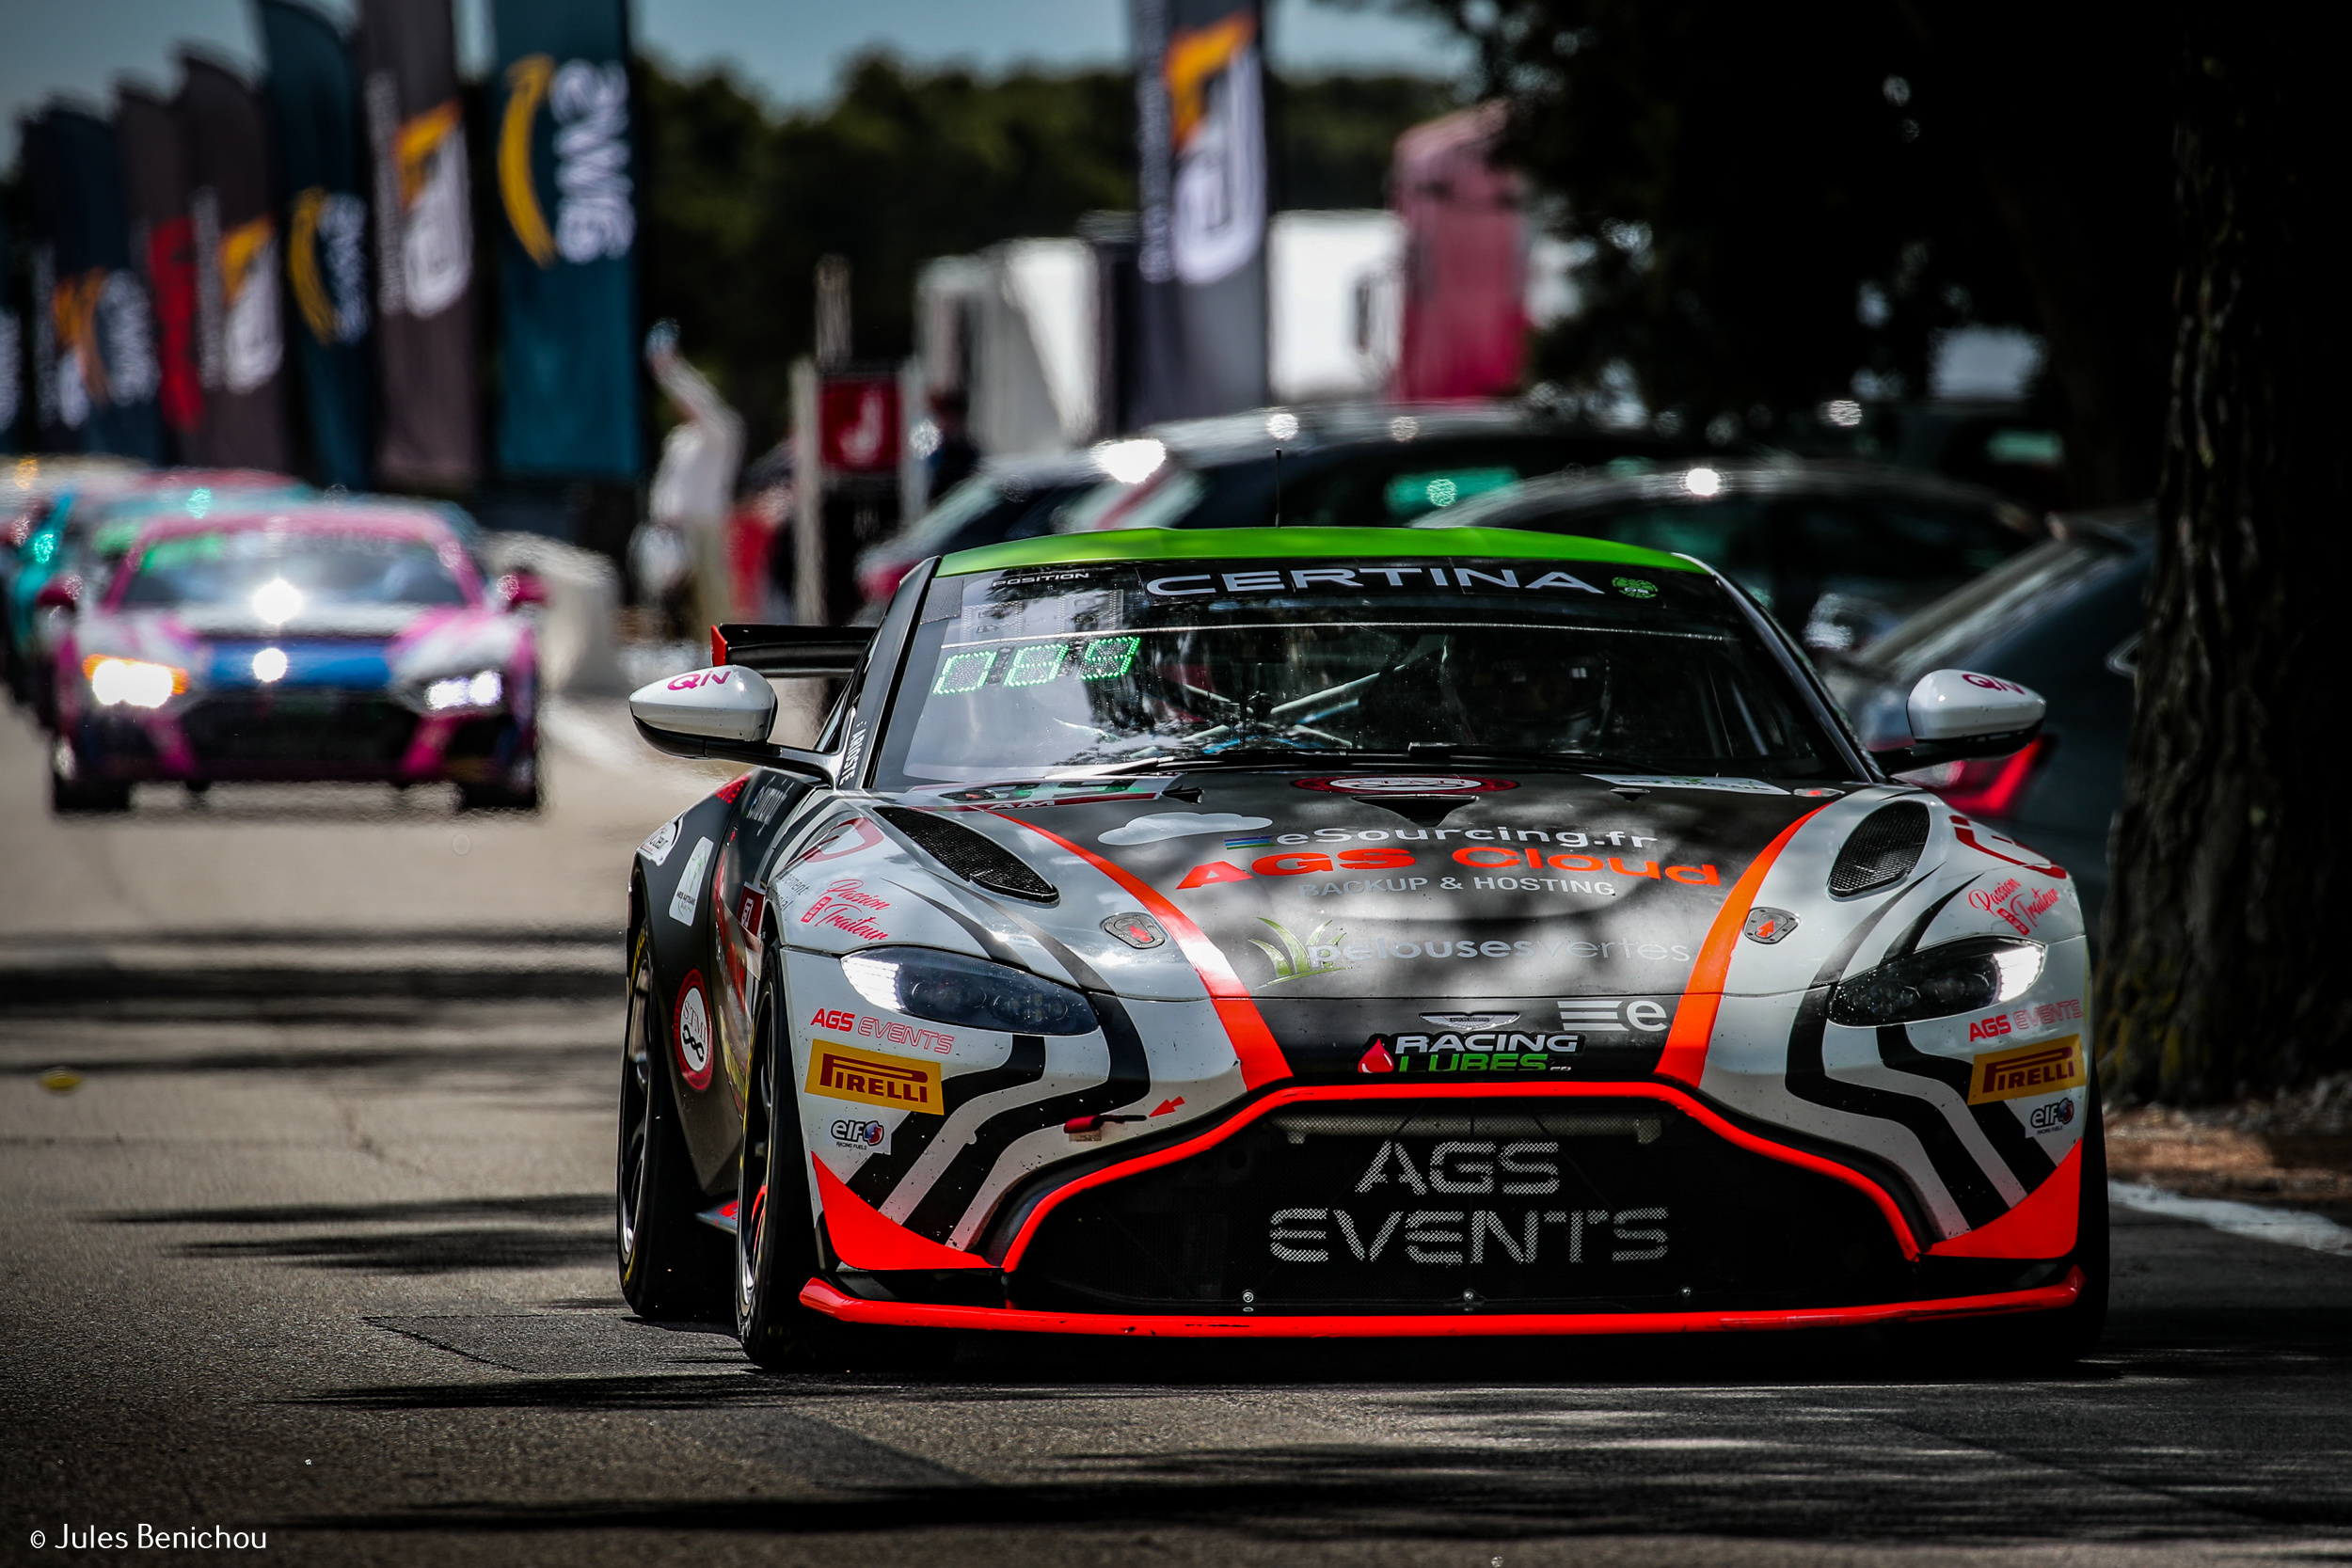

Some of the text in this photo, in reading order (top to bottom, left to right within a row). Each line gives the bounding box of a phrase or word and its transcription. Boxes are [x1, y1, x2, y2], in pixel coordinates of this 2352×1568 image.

[992, 572, 1090, 588] POSITION
[1146, 567, 1605, 595] CERTINA
[990, 800, 1056, 811] AM
[1276, 826, 1659, 848] eSourcing.fr
[1175, 846, 1722, 891] AGS Cloud
[818, 879, 891, 911] Passion
[1297, 876, 1616, 898] BACKUP & HOSTING
[810, 1008, 955, 1055] AGS EVENTS
[1969, 998, 2083, 1042] AGS EVENTS
[1394, 1034, 1580, 1054] RACING
[1398, 1053, 1549, 1073] LUBES
[1982, 1046, 2075, 1094] PIRELLI
[819, 1053, 929, 1103] PIRELLI
[2030, 1103, 2061, 1128] elf
[831, 1119, 866, 1141] elf
[1355, 1139, 1560, 1196] AGS
[1269, 1207, 1669, 1264] EVENTS
